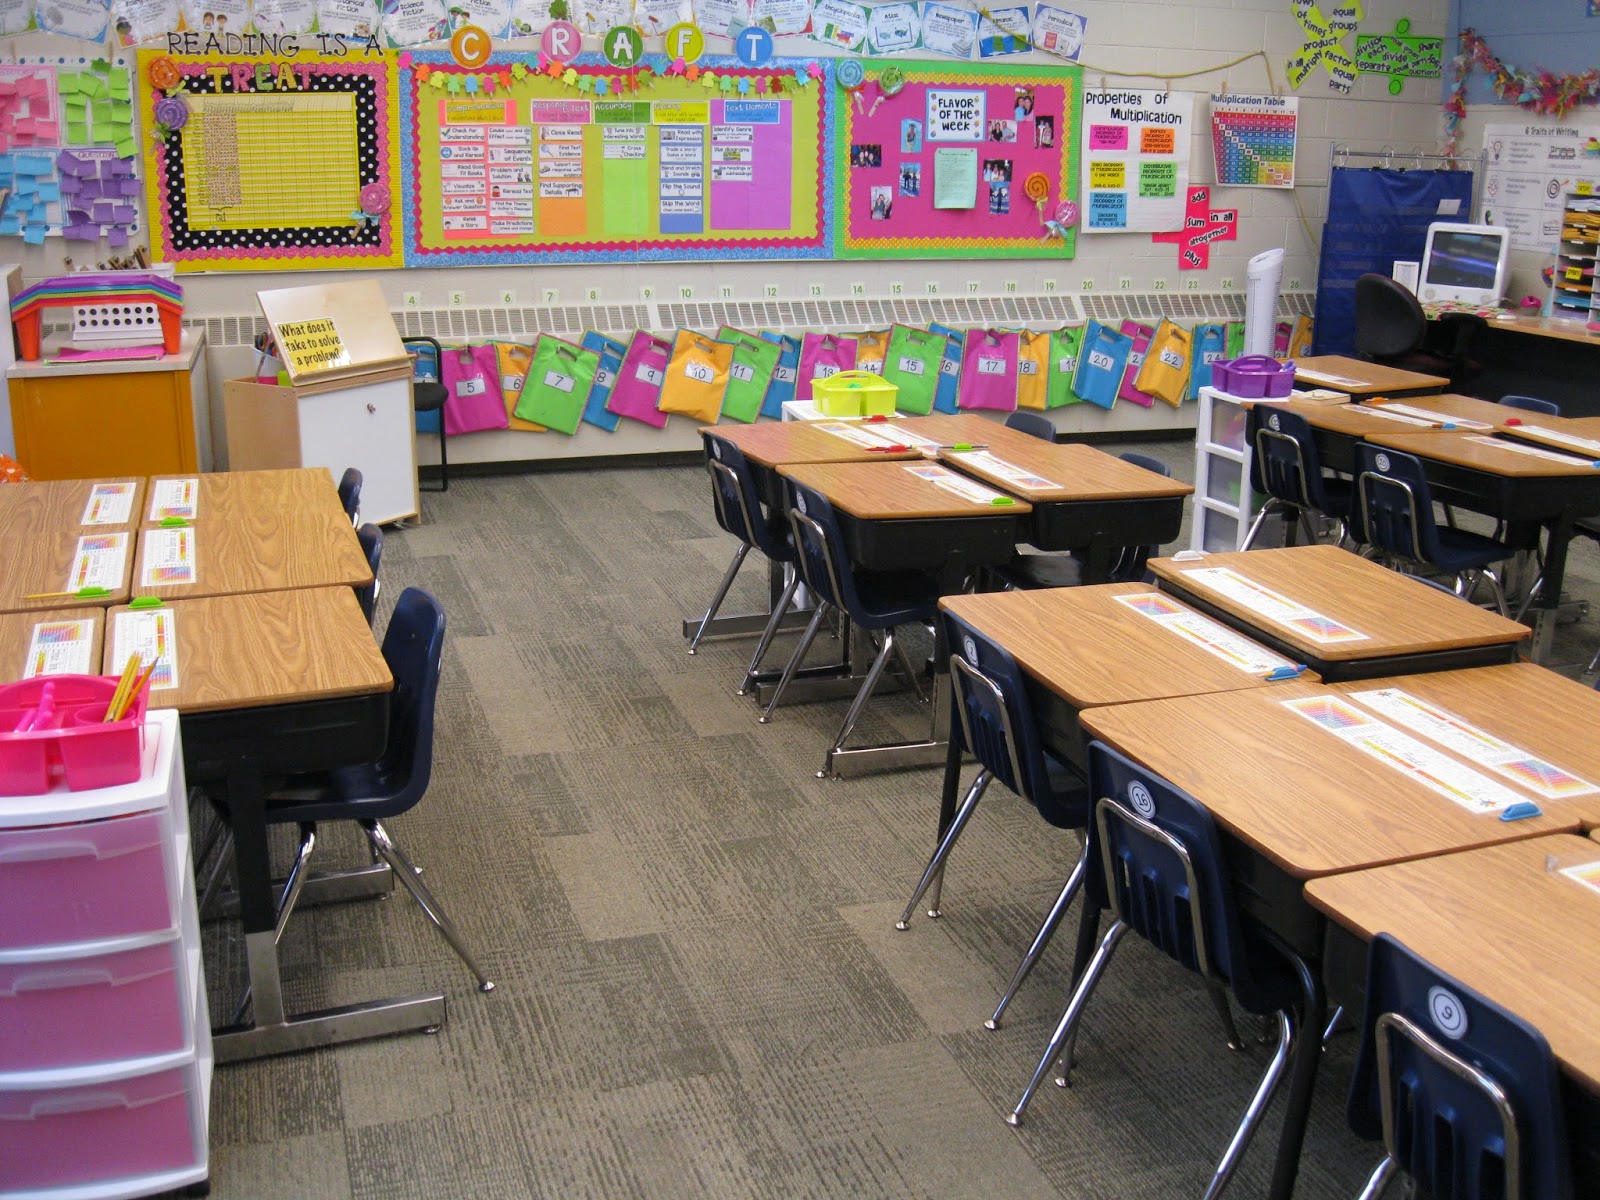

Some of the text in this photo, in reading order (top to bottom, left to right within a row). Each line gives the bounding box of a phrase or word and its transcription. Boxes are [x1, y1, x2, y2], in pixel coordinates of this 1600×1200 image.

[336, 4, 359, 12] Fiction
[400, 0, 424, 10] Science
[402, 8, 424, 16] Fiction
[824, 4, 860, 19] Encyclopedia
[1333, 8, 1356, 18] equal
[935, 12, 965, 24] Newspaper
[1048, 14, 1074, 27] Periodical
[1304, 20, 1327, 38] times
[1328, 21, 1358, 34] groups
[166, 32, 384, 58] READING IS A
[461, 27, 762, 61] C R A F T
[1303, 36, 1338, 52] product
[1356, 36, 1383, 56] divisor
[1368, 44, 1387, 58] each
[1324, 50, 1352, 67] factor
[1382, 52, 1407, 62] divide
[1295, 50, 1322, 84] multiply
[206, 63, 317, 93] TREAT
[1333, 67, 1355, 82] equal
[1329, 80, 1350, 94] parts
[938, 98, 974, 108] FLAVOR
[1086, 92, 1142, 106] Properties
[939, 110, 951, 119] OF
[1110, 108, 1182, 124] Multiplication
[1530, 127, 1547, 135] Traits
[1556, 128, 1579, 137] Writing
[1192, 192, 1206, 202] add
[1210, 212, 1233, 222] in all
[1190, 226, 1228, 246] altogether
[1184, 250, 1201, 266] plus
[892, 285, 901, 293] 15
[928, 284, 936, 293] 16
[970, 284, 977, 292] 17
[1006, 283, 1015, 291] 18
[1046, 282, 1054, 290] 19
[1083, 281, 1092, 290] 20
[1121, 280, 1130, 288] 21
[1155, 280, 1164, 289] 22
[1188, 280, 1198, 289] 23
[1222, 280, 1232, 289] 24
[1290, 280, 1299, 289] 26
[644, 289, 650, 298] 9
[681, 289, 691, 298] 10
[723, 288, 730, 297] 11
[768, 287, 776, 296] 12
[812, 286, 820, 295] 13
[853, 285, 862, 294] 14
[409, 296, 415, 304] 4
[454, 294, 460, 303] 5
[505, 294, 510, 302] 6
[547, 292, 553, 301] 7
[590, 290, 596, 300] 8
[278, 320, 334, 338] What does it
[286, 335, 341, 352] take to solve
[297, 348, 341, 367] a problem?
[1094, 355, 1108, 367] 20
[1164, 354, 1178, 365] 22
[733, 365, 745, 376] 11
[865, 364, 877, 374] 14
[906, 360, 917, 371] 15
[942, 361, 950, 371] 16
[986, 361, 997, 371] 17
[1019, 362, 1030, 372] 18
[598, 372, 604, 382] 8
[647, 370, 654, 381] 9
[694, 369, 705, 379] 10
[776, 368, 787, 378] 12
[823, 368, 833, 376] 13
[514, 379, 520, 388] 6
[555, 376, 564, 386] 7
[467, 382, 474, 392] 5
[1137, 792, 1149, 805] 16
